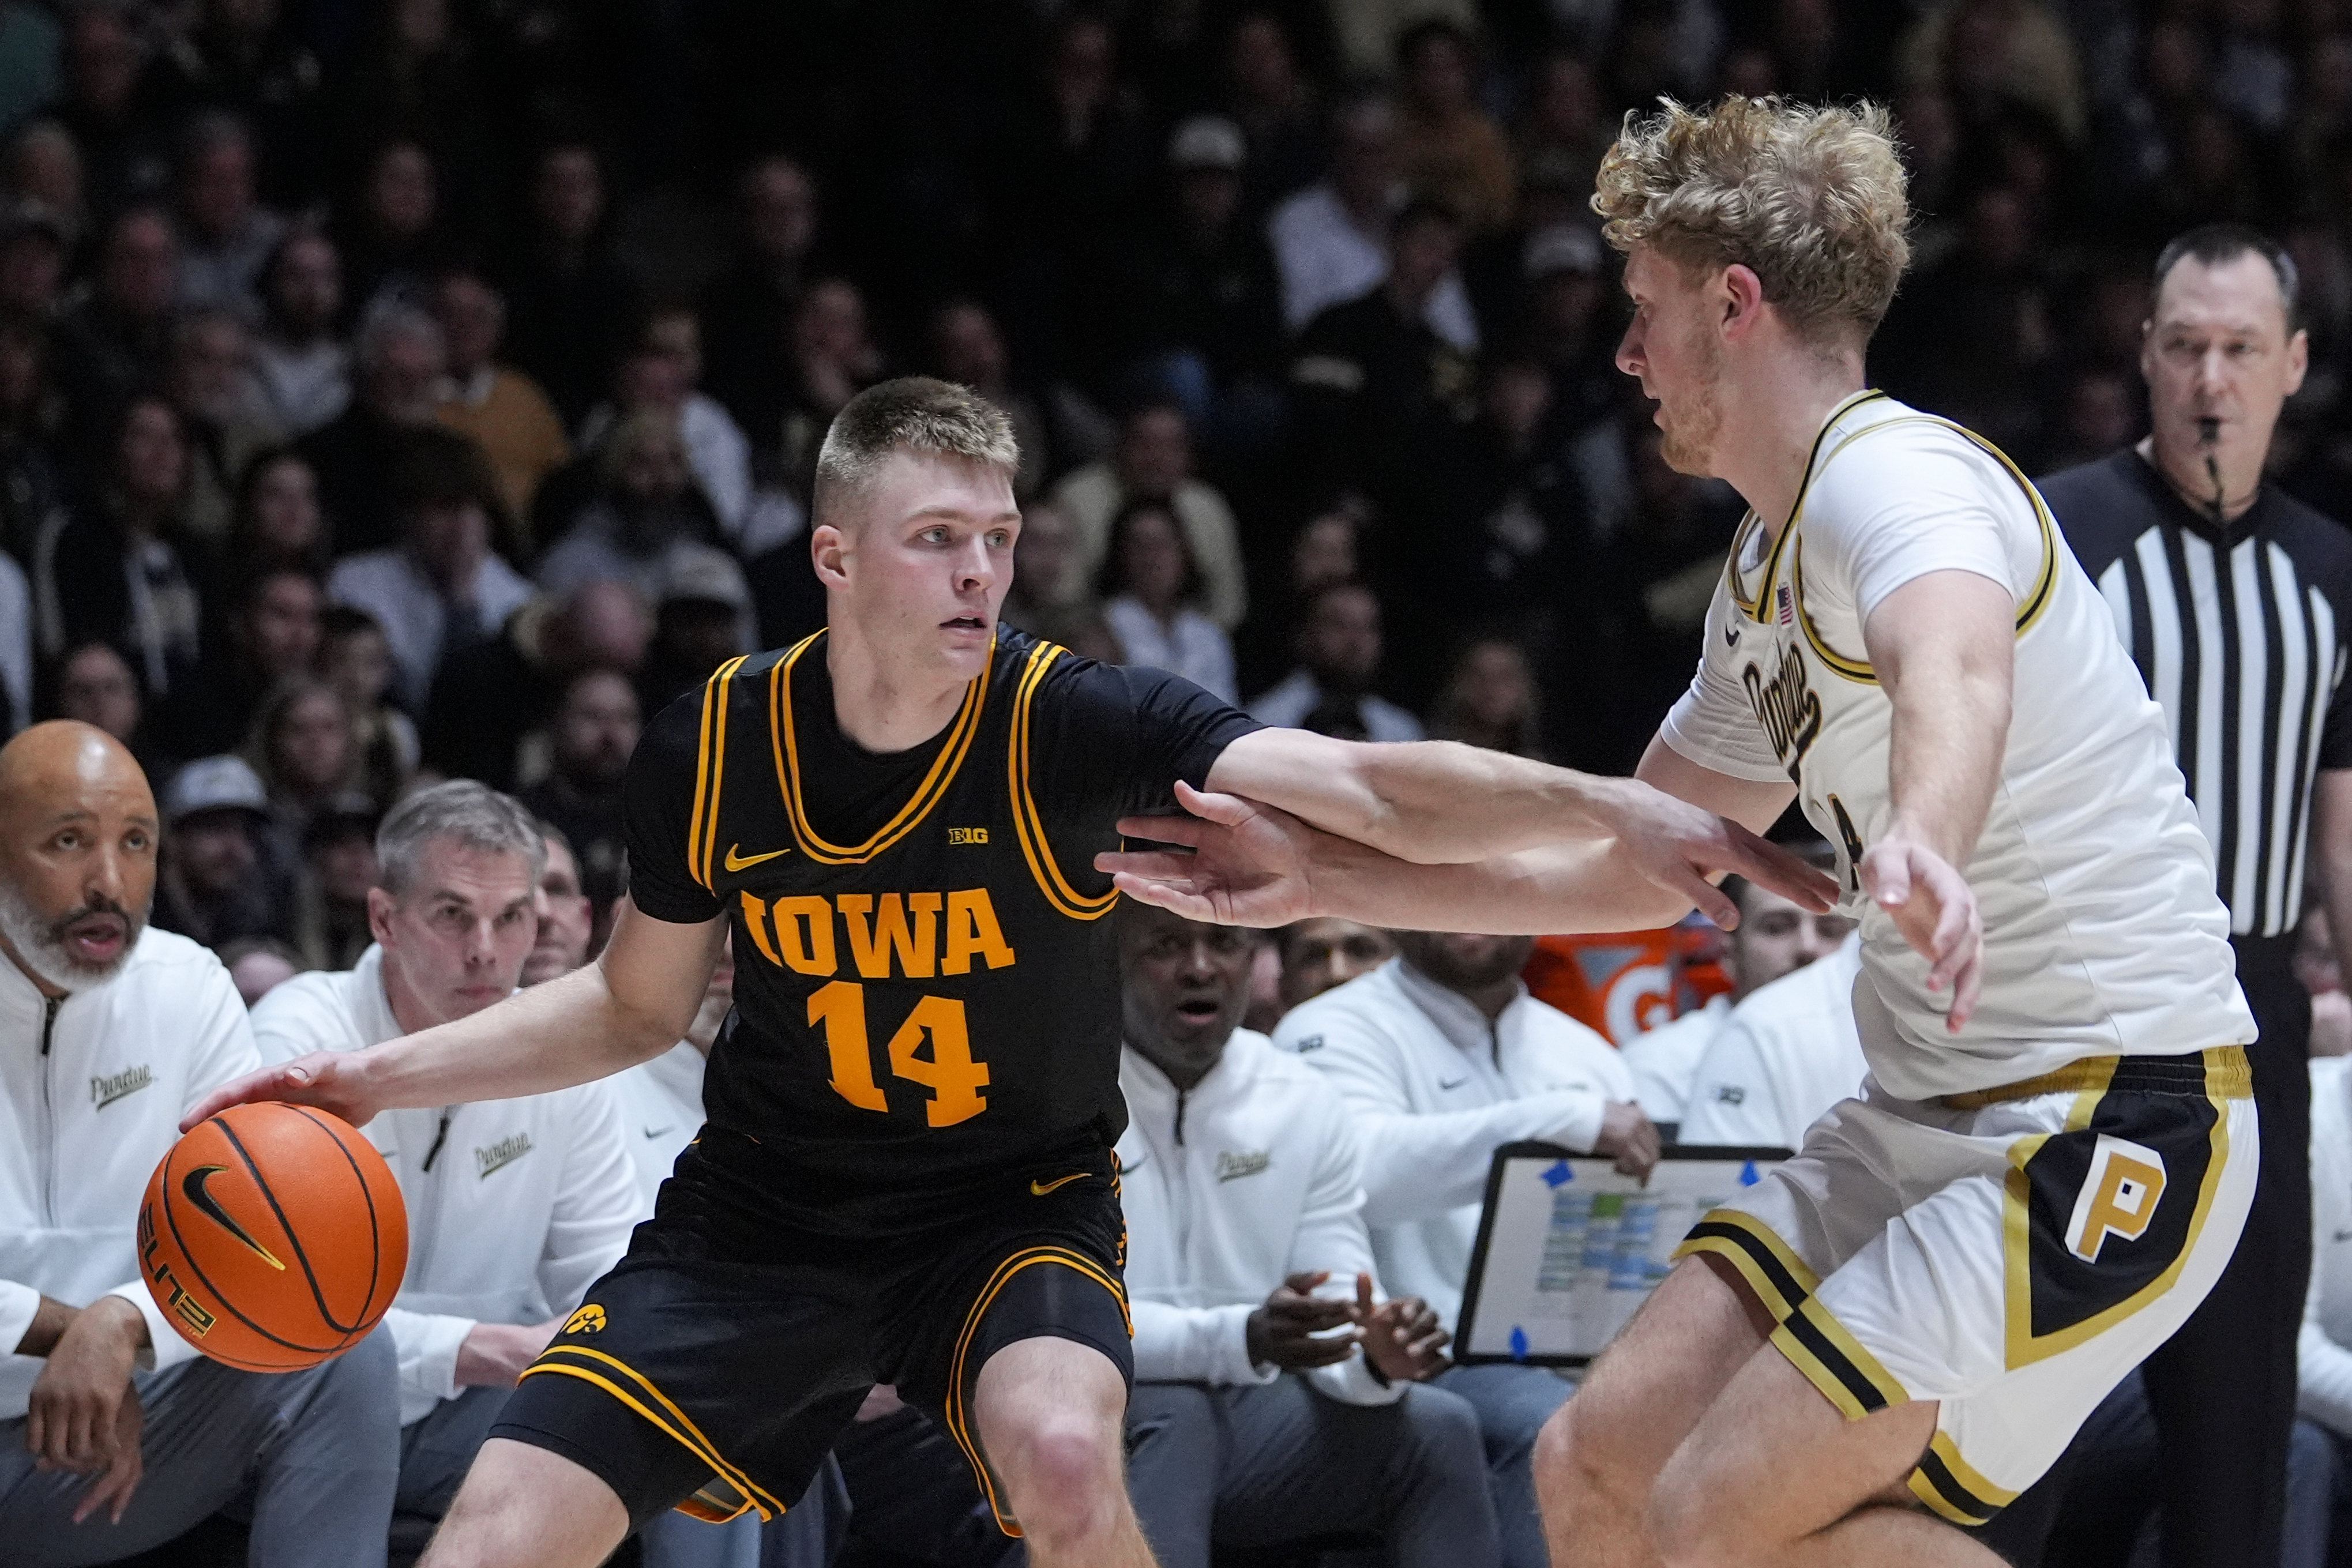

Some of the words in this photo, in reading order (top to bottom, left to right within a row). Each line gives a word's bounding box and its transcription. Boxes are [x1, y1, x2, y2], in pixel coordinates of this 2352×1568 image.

[741, 888, 1016, 978] IOWA
[807, 980, 990, 1127] 14
[2064, 1132, 2168, 1265] P
[139, 1202, 217, 1340] ELITE
